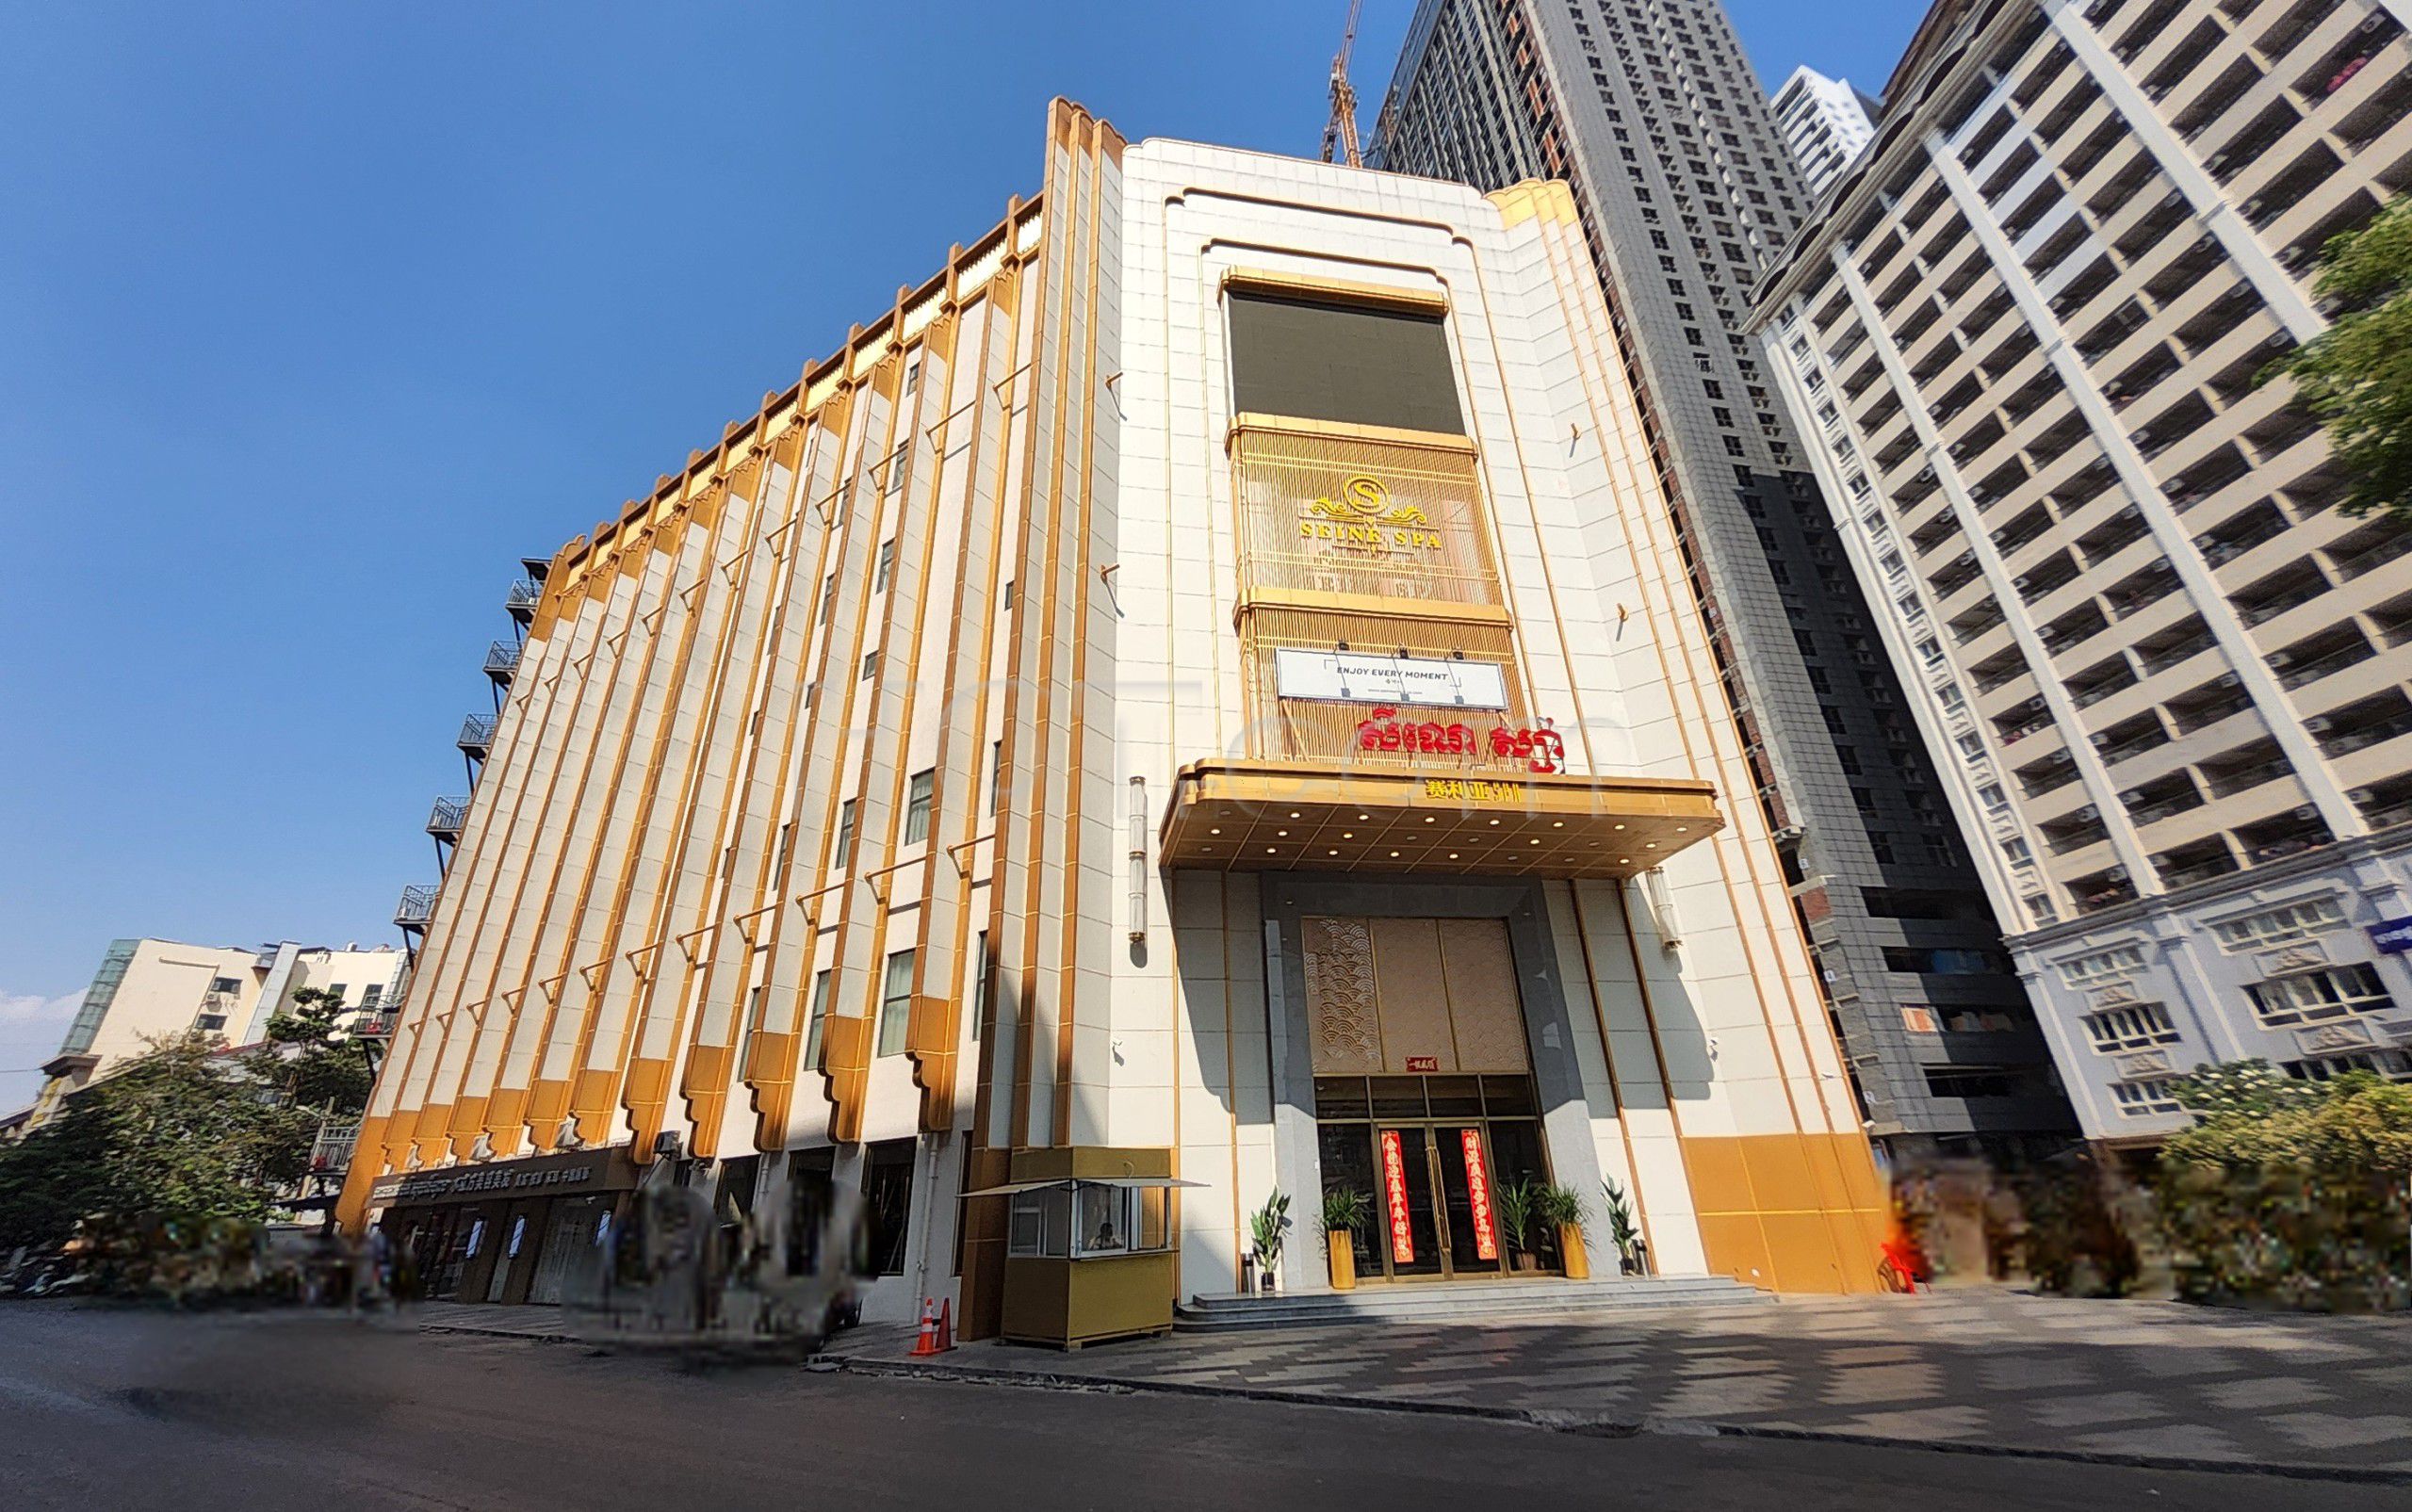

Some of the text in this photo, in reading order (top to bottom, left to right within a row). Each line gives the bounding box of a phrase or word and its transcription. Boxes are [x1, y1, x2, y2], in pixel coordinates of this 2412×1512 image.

[1353, 480, 1381, 506] S
[1299, 522, 1442, 549] SEINE SPA
[1336, 666, 1449, 681] ENJOY EVERY MOMENT
